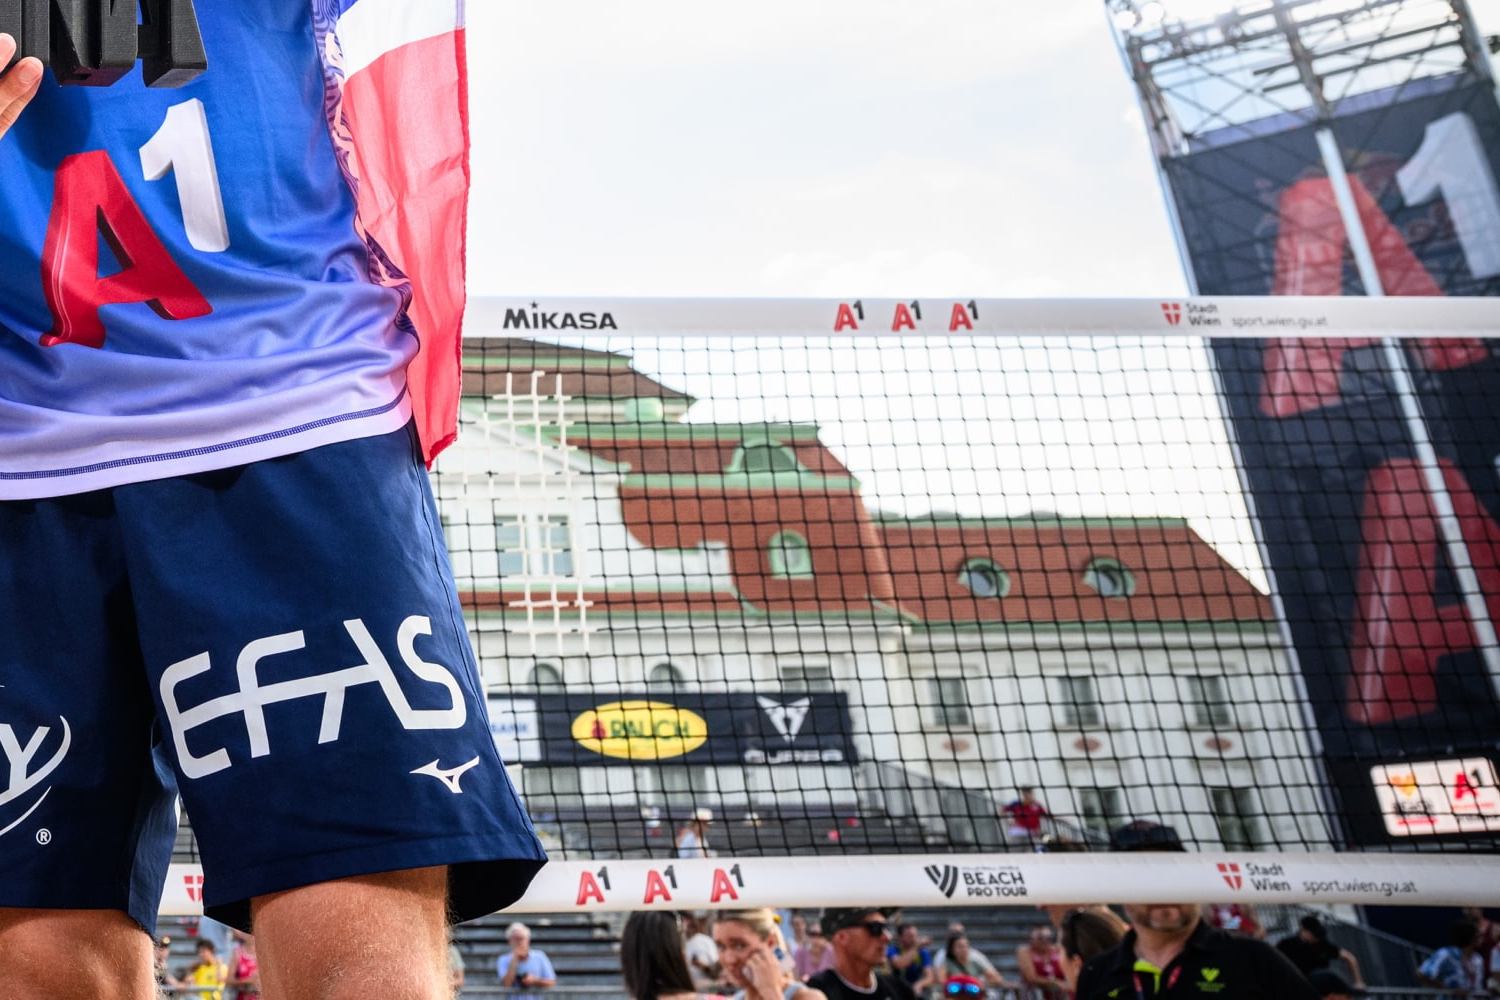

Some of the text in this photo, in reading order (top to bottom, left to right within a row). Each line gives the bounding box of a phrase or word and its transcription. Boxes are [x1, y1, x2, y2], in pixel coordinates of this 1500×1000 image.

[39, 97, 231, 348] A1
[834, 300, 864, 332] A1
[892, 300, 921, 332] A1
[949, 300, 979, 331] A1
[1186, 303, 1219, 313] Stadt
[1188, 315, 1221, 326] Wien
[160, 615, 466, 779] EFAS
[610, 710, 690, 738] RAUCH
[643, 865, 678, 904] A1
[710, 863, 744, 903] A1
[963, 872, 1025, 885] BEACH
[1246, 863, 1283, 876] Stadt
[576, 866, 611, 905] A1
[967, 887, 1027, 897] PRO TOUR
[1251, 878, 1418, 896] Wien sport.wien.gv.at
